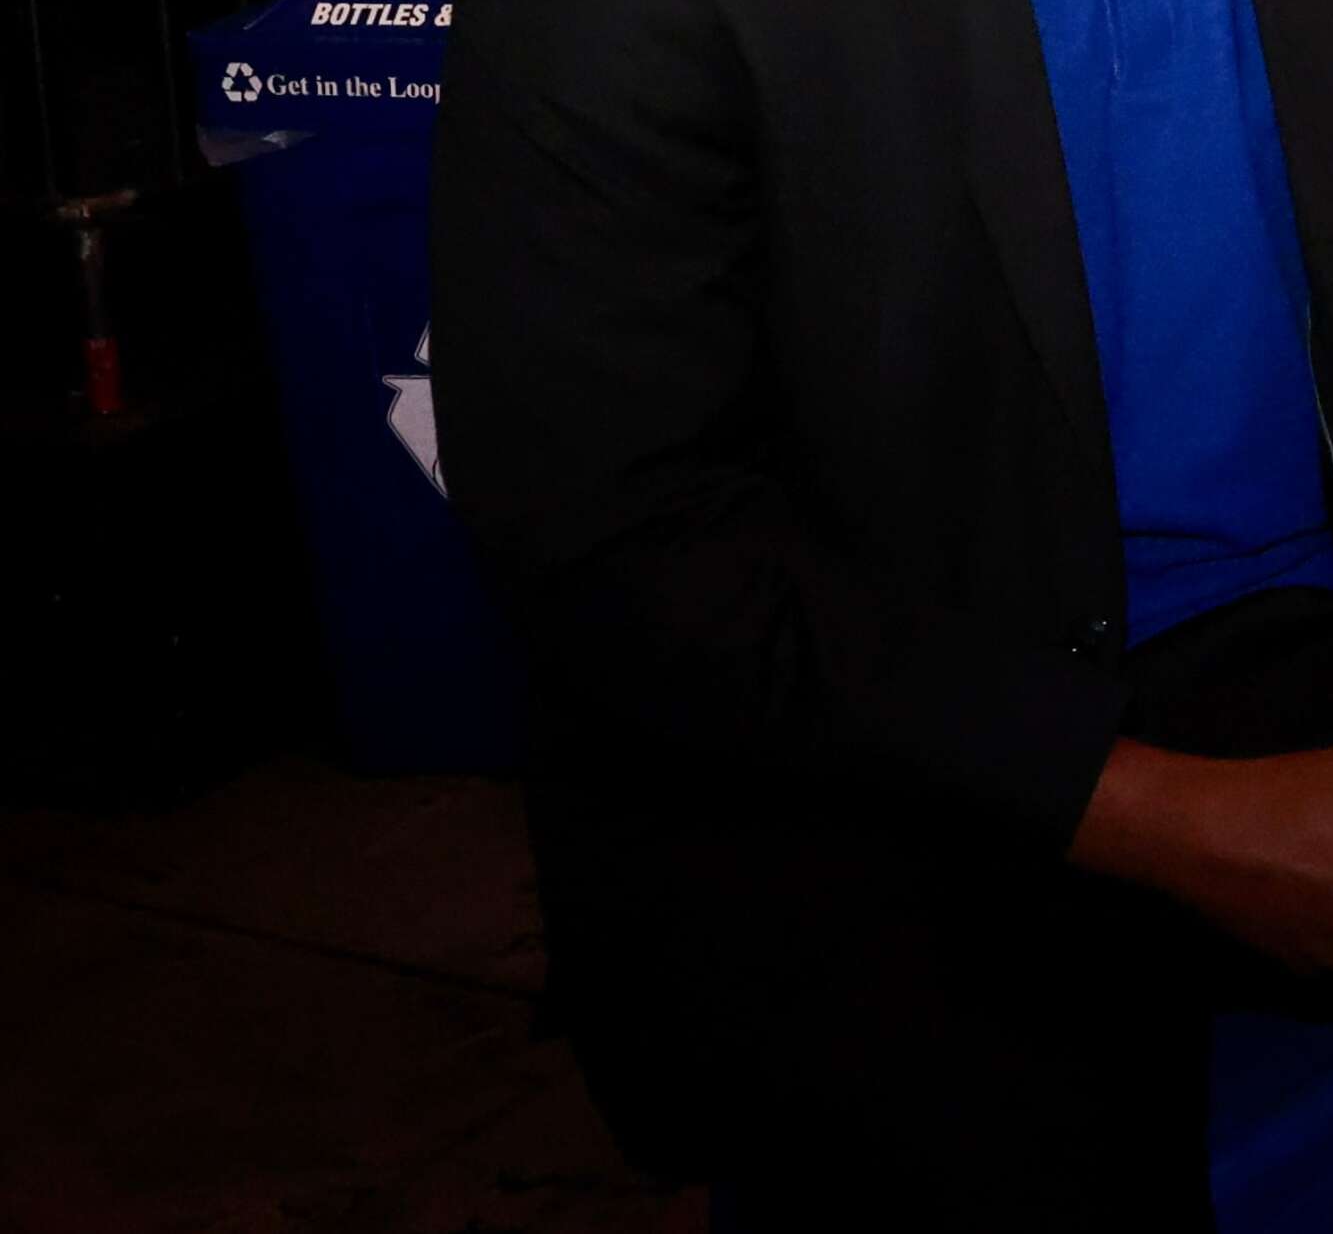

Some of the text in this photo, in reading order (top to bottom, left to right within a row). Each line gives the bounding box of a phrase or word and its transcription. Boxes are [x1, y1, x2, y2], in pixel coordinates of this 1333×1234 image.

[311, 2, 454, 27] BOTTLES &
[266, 73, 309, 96] Get
[316, 75, 339, 97] in
[345, 75, 383, 98] the
